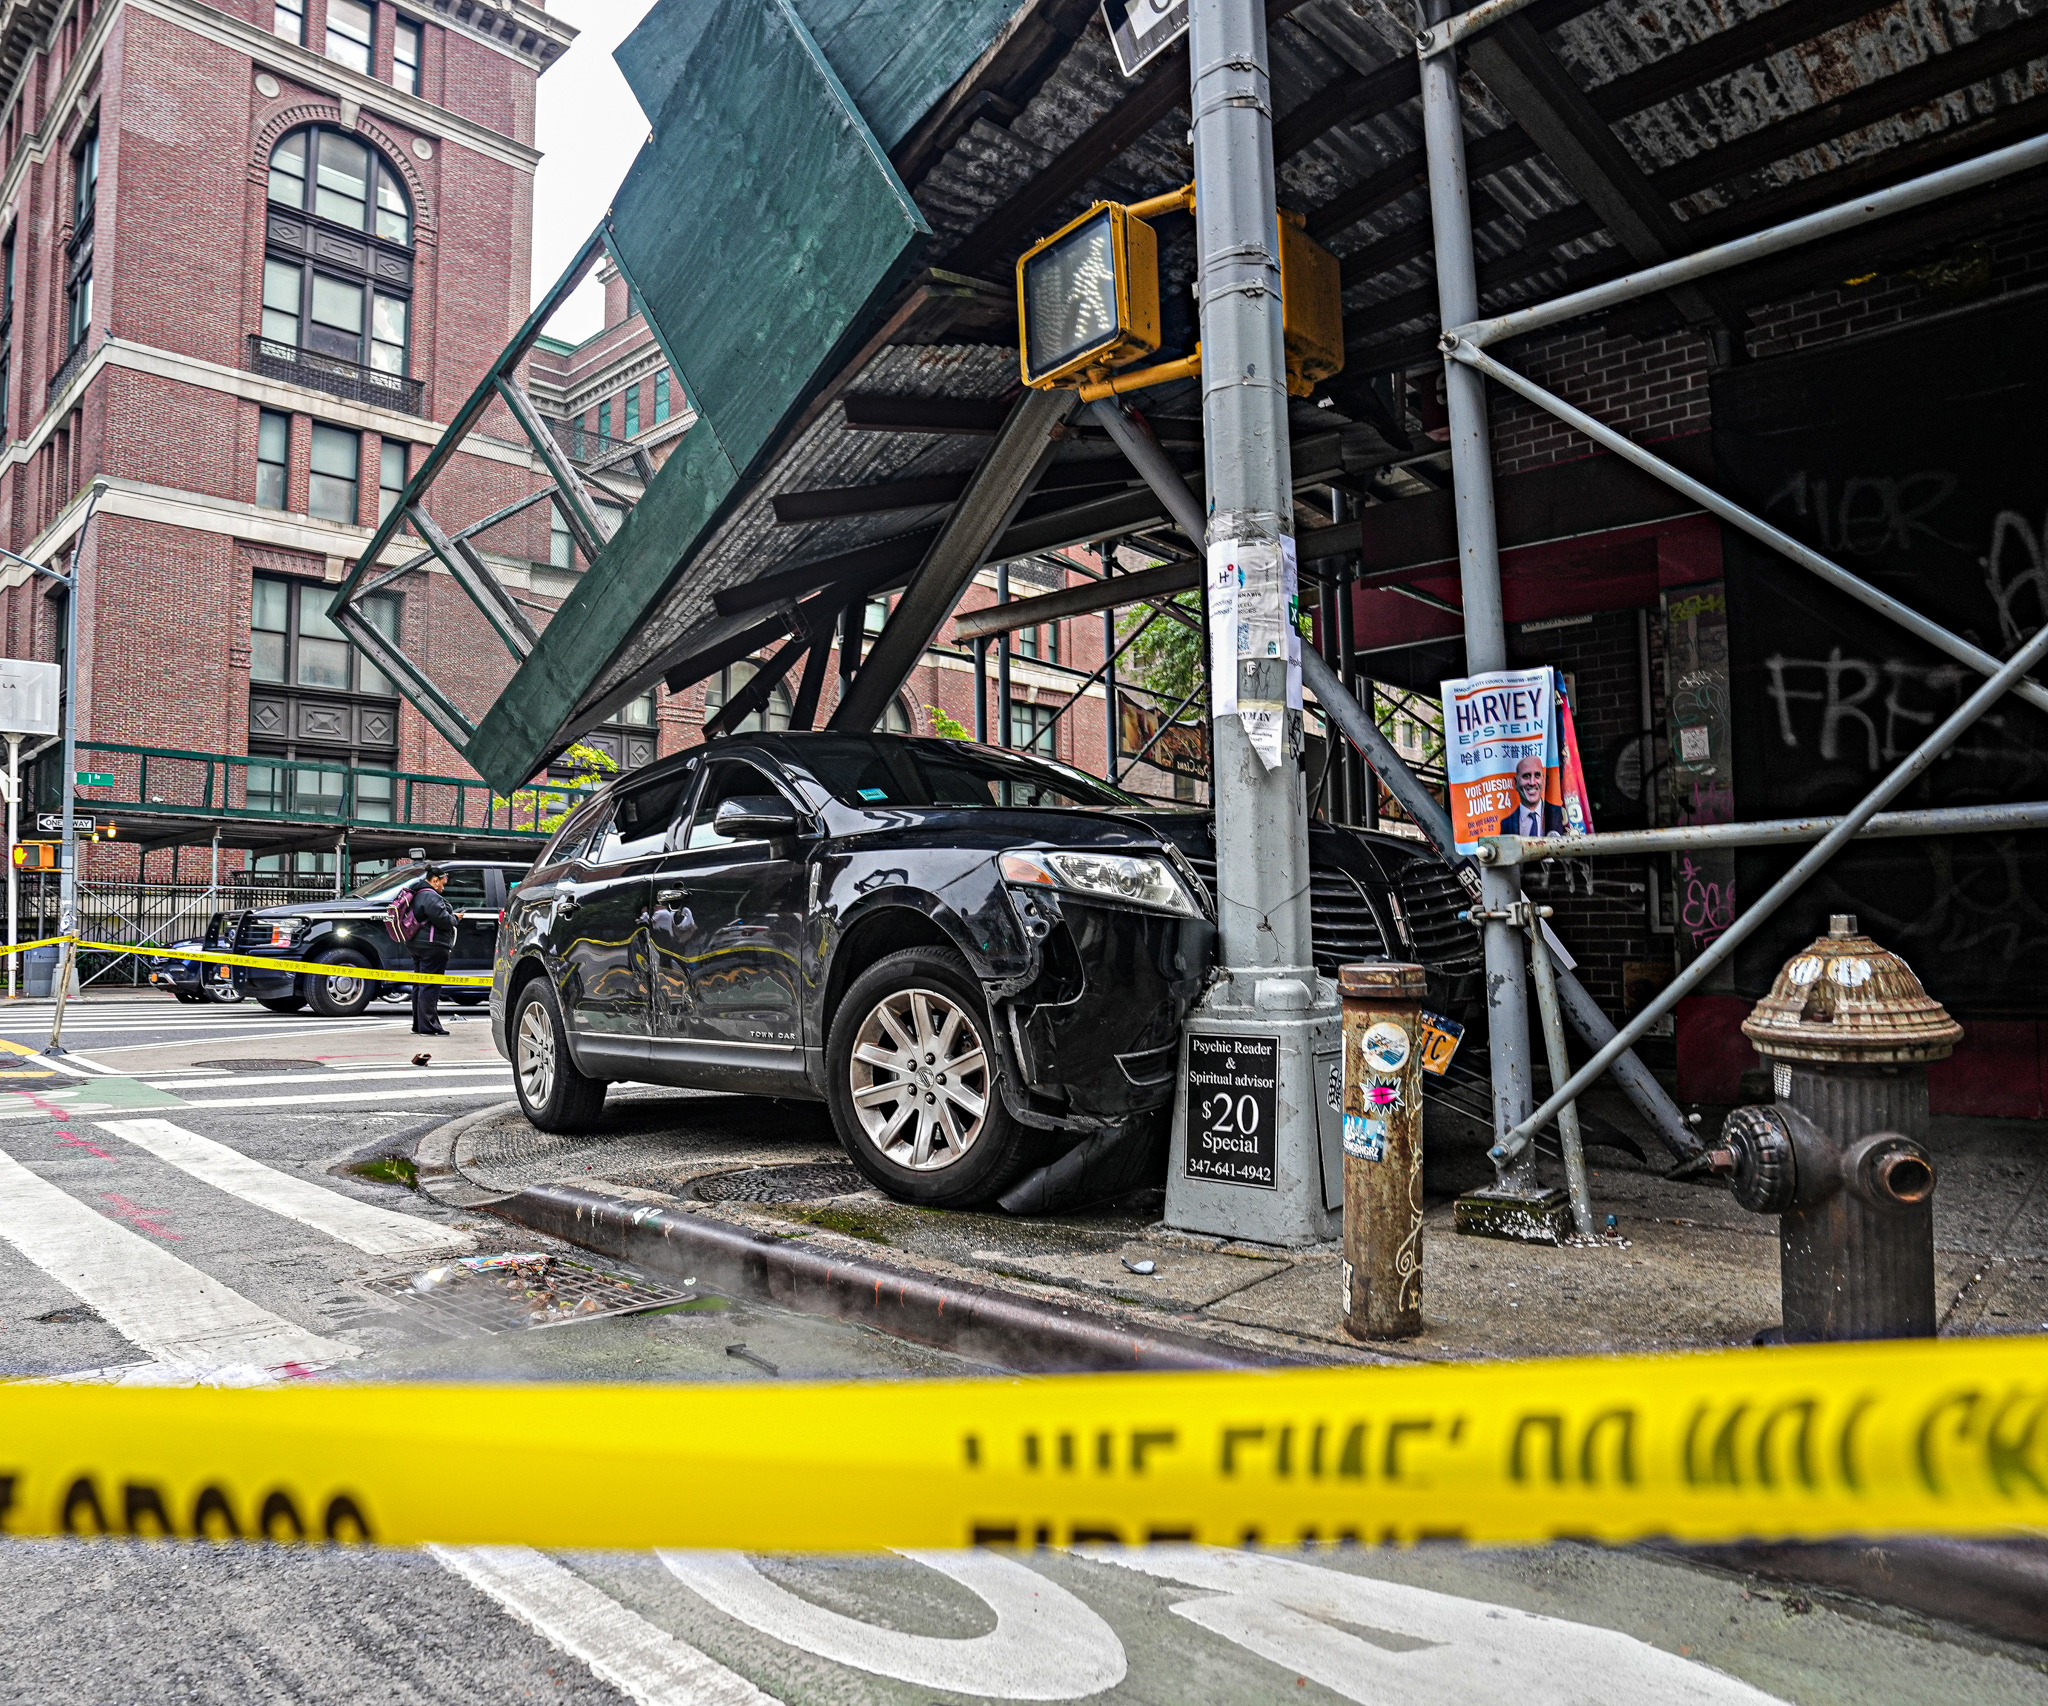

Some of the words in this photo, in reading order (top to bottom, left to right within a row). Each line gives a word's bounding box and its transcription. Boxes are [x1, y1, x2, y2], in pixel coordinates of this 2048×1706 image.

[1455, 687, 1543, 734] HARVEY
[1459, 719, 1544, 745] EPSTEIN
[1464, 784, 1482, 799] VOTE
[1466, 794, 1494, 818] JUNE
[1496, 791, 1512, 810] 24
[45, 819, 62, 827] ONE
[73, 820, 91, 828] WAY
[750, 1030, 774, 1039] TOWN
[778, 1032, 796, 1040] CAR
[1193, 1039, 1232, 1055] Psychic
[1234, 1041, 1273, 1056] Reader
[1225, 1056, 1237, 1070] &
[1189, 1070, 1233, 1086] Spiritual
[1234, 1073, 1275, 1089] advisor
[1201, 1091, 1260, 1135] $20
[1202, 1130, 1259, 1154] Special
[1189, 1158, 1272, 1182] 347-641-4942
